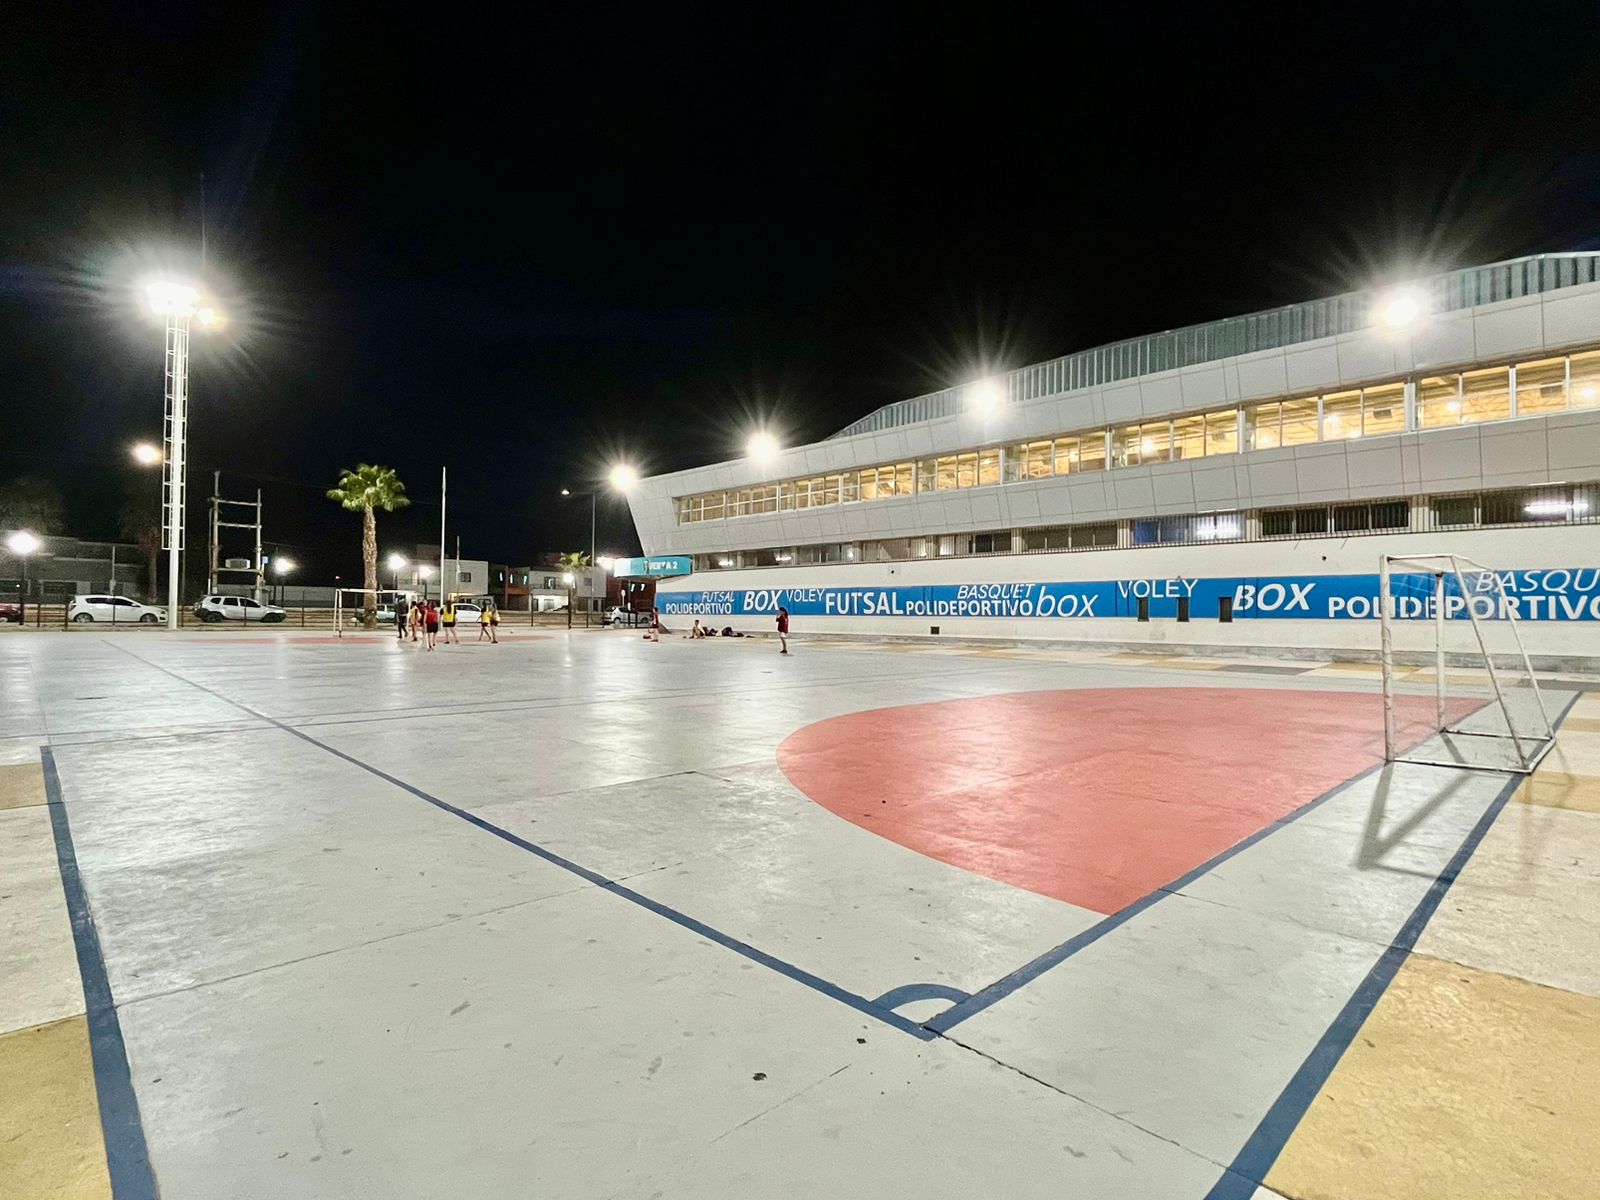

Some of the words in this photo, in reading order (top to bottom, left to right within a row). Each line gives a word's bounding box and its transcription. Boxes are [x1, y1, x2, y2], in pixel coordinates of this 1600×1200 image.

[672, 560, 678, 570] 2
[701, 590, 735, 603] FUTSAL
[786, 588, 826, 603] VOLEY
[957, 583, 1036, 600] BASQUET
[1117, 578, 1199, 599] VOLEY
[1232, 582, 1316, 612] BOX
[665, 603, 732, 615] POLIDEPORTIVO
[743, 590, 783, 611] BOX
[825, 592, 904, 615] FUTSAL
[906, 600, 1033, 616] POLIDEPORTIVO
[1035, 586, 1099, 617] box
